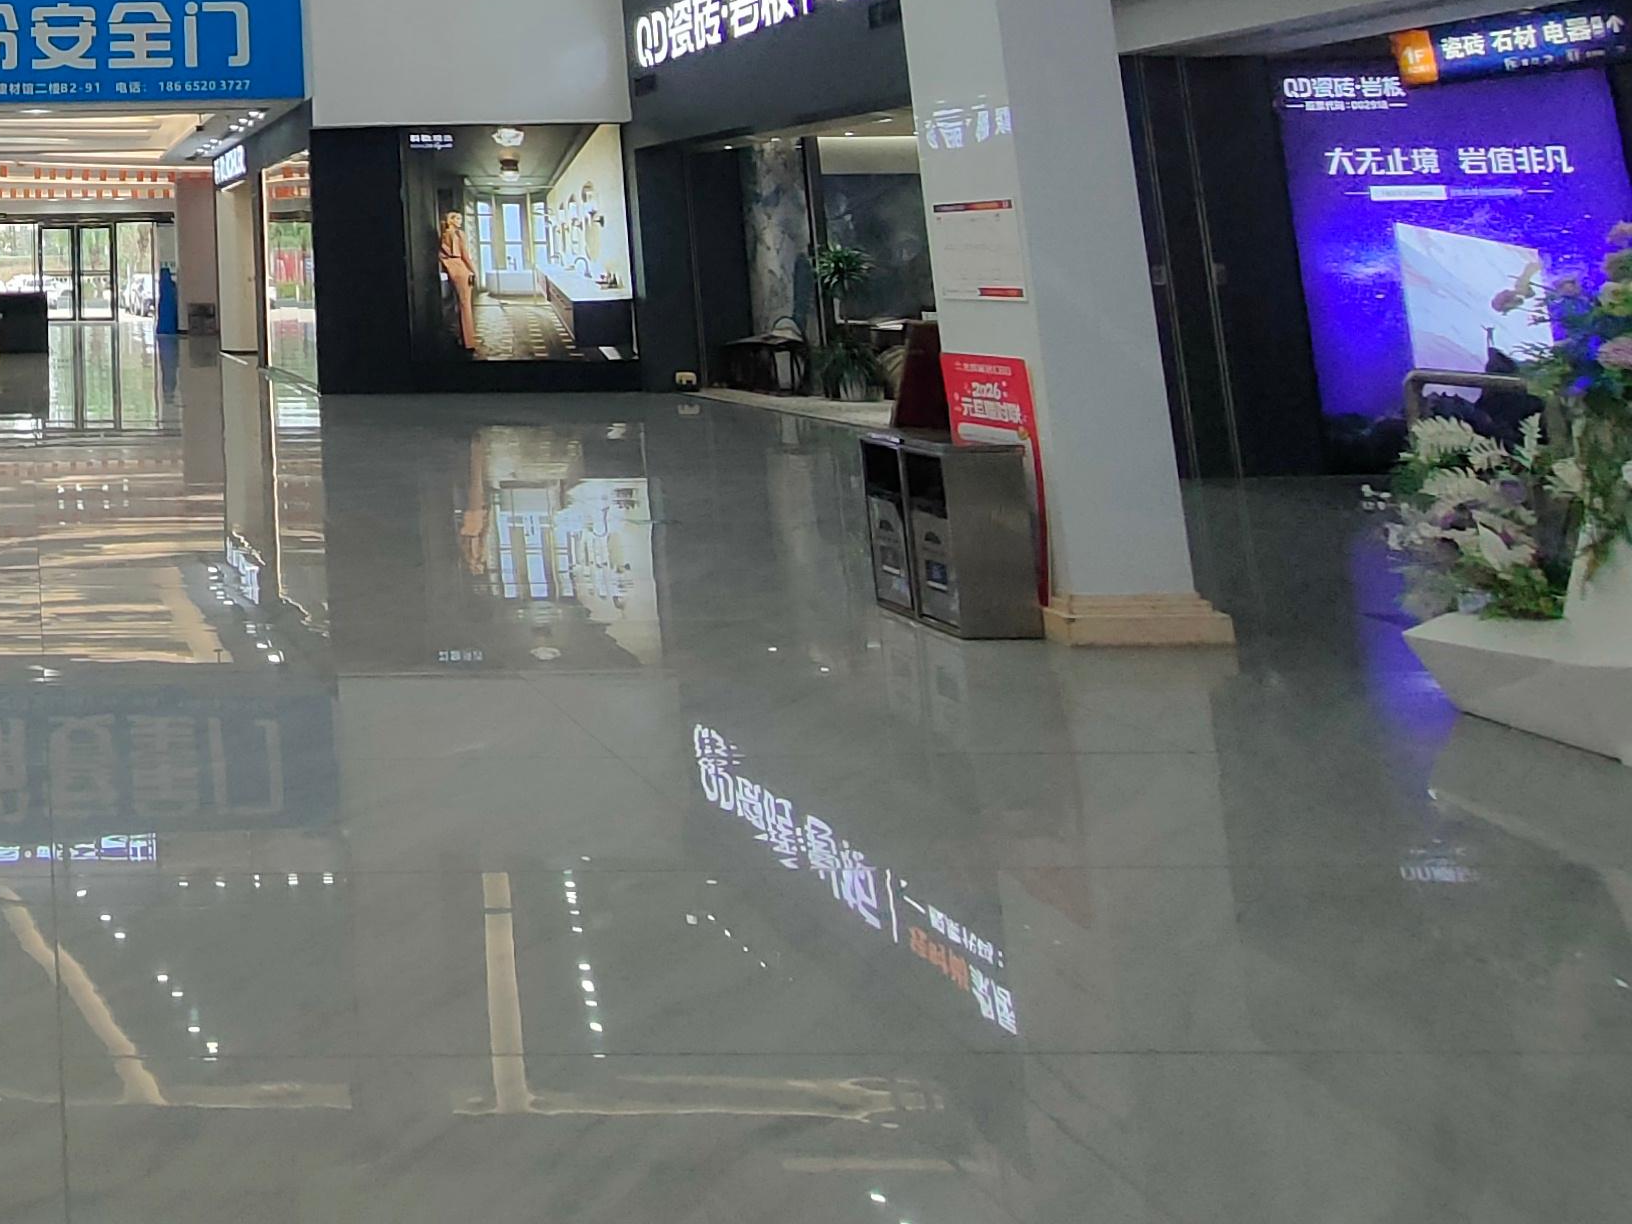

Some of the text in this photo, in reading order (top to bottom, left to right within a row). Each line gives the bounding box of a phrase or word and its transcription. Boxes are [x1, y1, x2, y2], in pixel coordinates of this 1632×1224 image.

[1440, 16, 1592, 61] 瓷砖 石材 电器
[158, 80, 183, 92] 186
[184, 79, 216, 91] 6520
[218, 79, 251, 91] 3727
[1324, 145, 1575, 176] 大无止境 岩值非凡
[971, 380, 1002, 401] 2026
